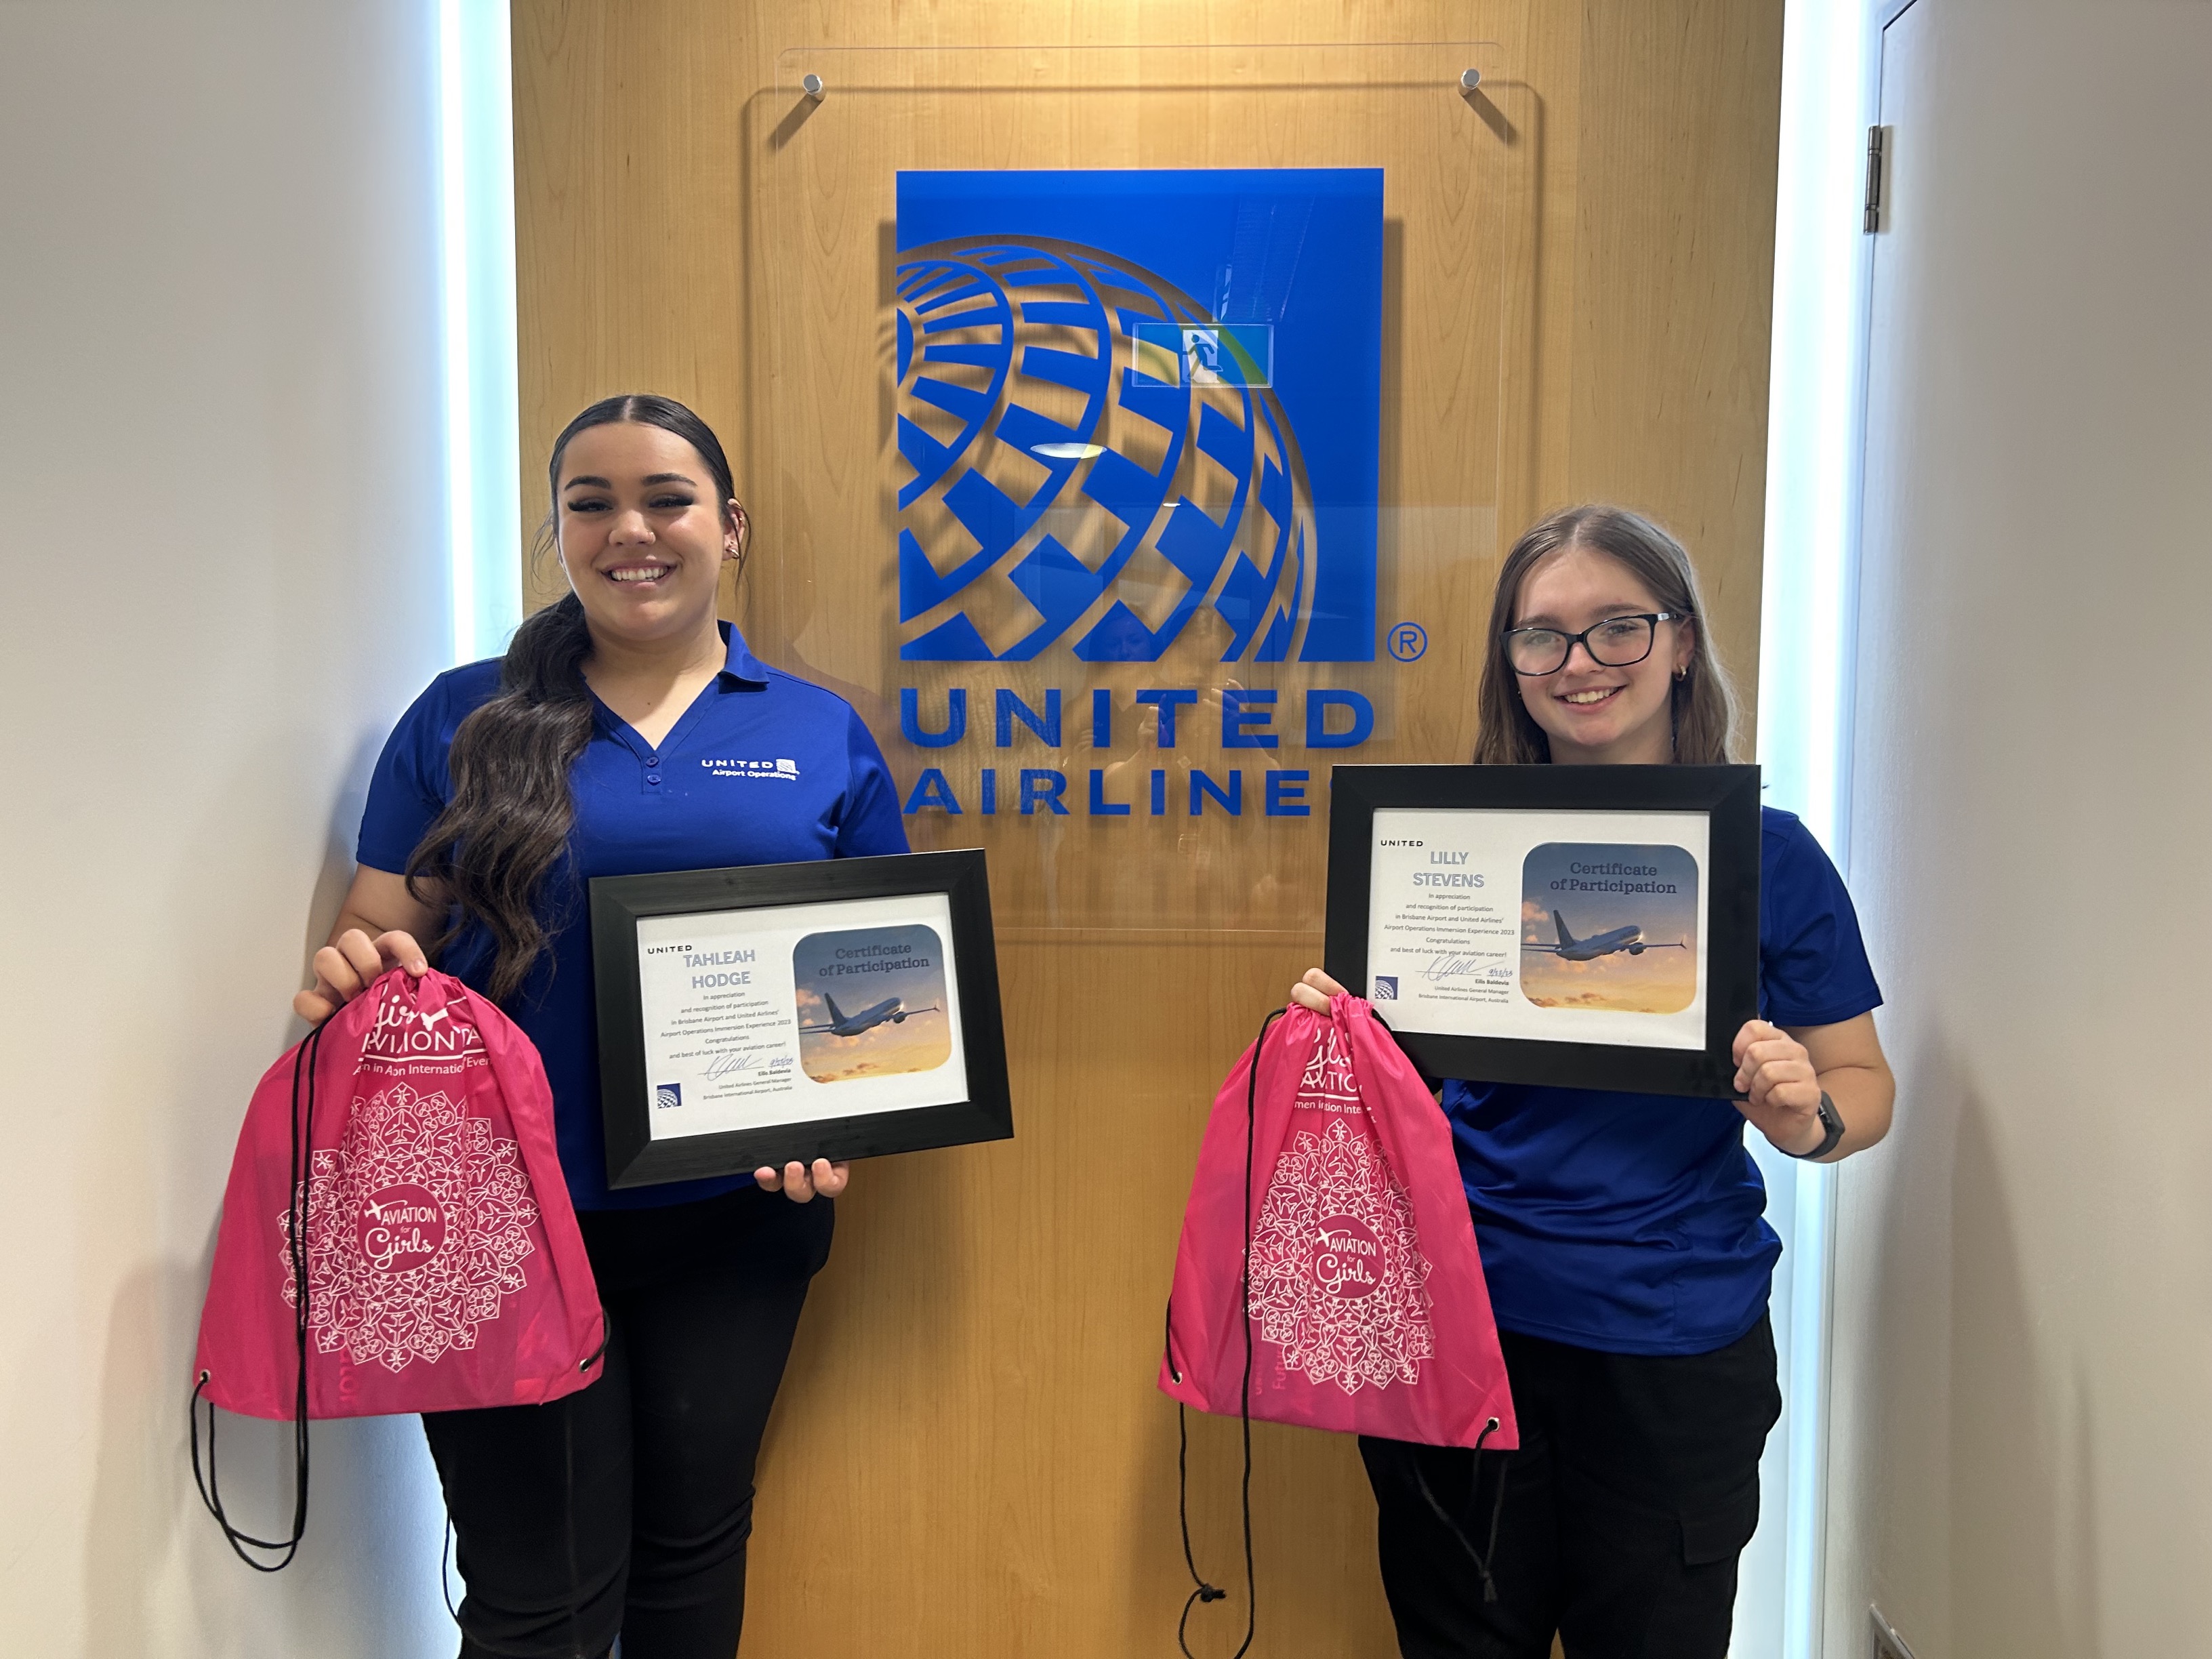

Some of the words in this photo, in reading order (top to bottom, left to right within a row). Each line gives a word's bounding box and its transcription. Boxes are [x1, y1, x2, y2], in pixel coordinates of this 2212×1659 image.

[899, 688, 1374, 749] UNITED
[701, 760, 773, 768] UNITED
[747, 771, 796, 780] Operations
[903, 769, 1332, 817] AIRLINE
[1431, 851, 1469, 865] LILLY
[1570, 862, 1657, 876] Certificate
[1413, 873, 1484, 887] STEVENS
[1551, 879, 1567, 890] of
[1569, 879, 1677, 895] Participation
[648, 945, 692, 954] UNITED
[836, 944, 912, 959] Certificate
[683, 949, 756, 967] TAHLEAH
[819, 964, 834, 977] of
[836, 958, 930, 975] Participation
[692, 971, 751, 988] HODGE
[710, 991, 745, 1000] appreciation
[693, 1004, 725, 1013] recognition
[733, 1000, 769, 1010] participation
[682, 1027, 714, 1036] Operations
[746, 1021, 776, 1029] Experience
[705, 1035, 749, 1044] Congratulations
[381, 1207, 436, 1225] AVIATION
[365, 1227, 434, 1269] Girls
[1330, 1237, 1376, 1256] AVIATION
[1316, 1254, 1376, 1294] Girls
